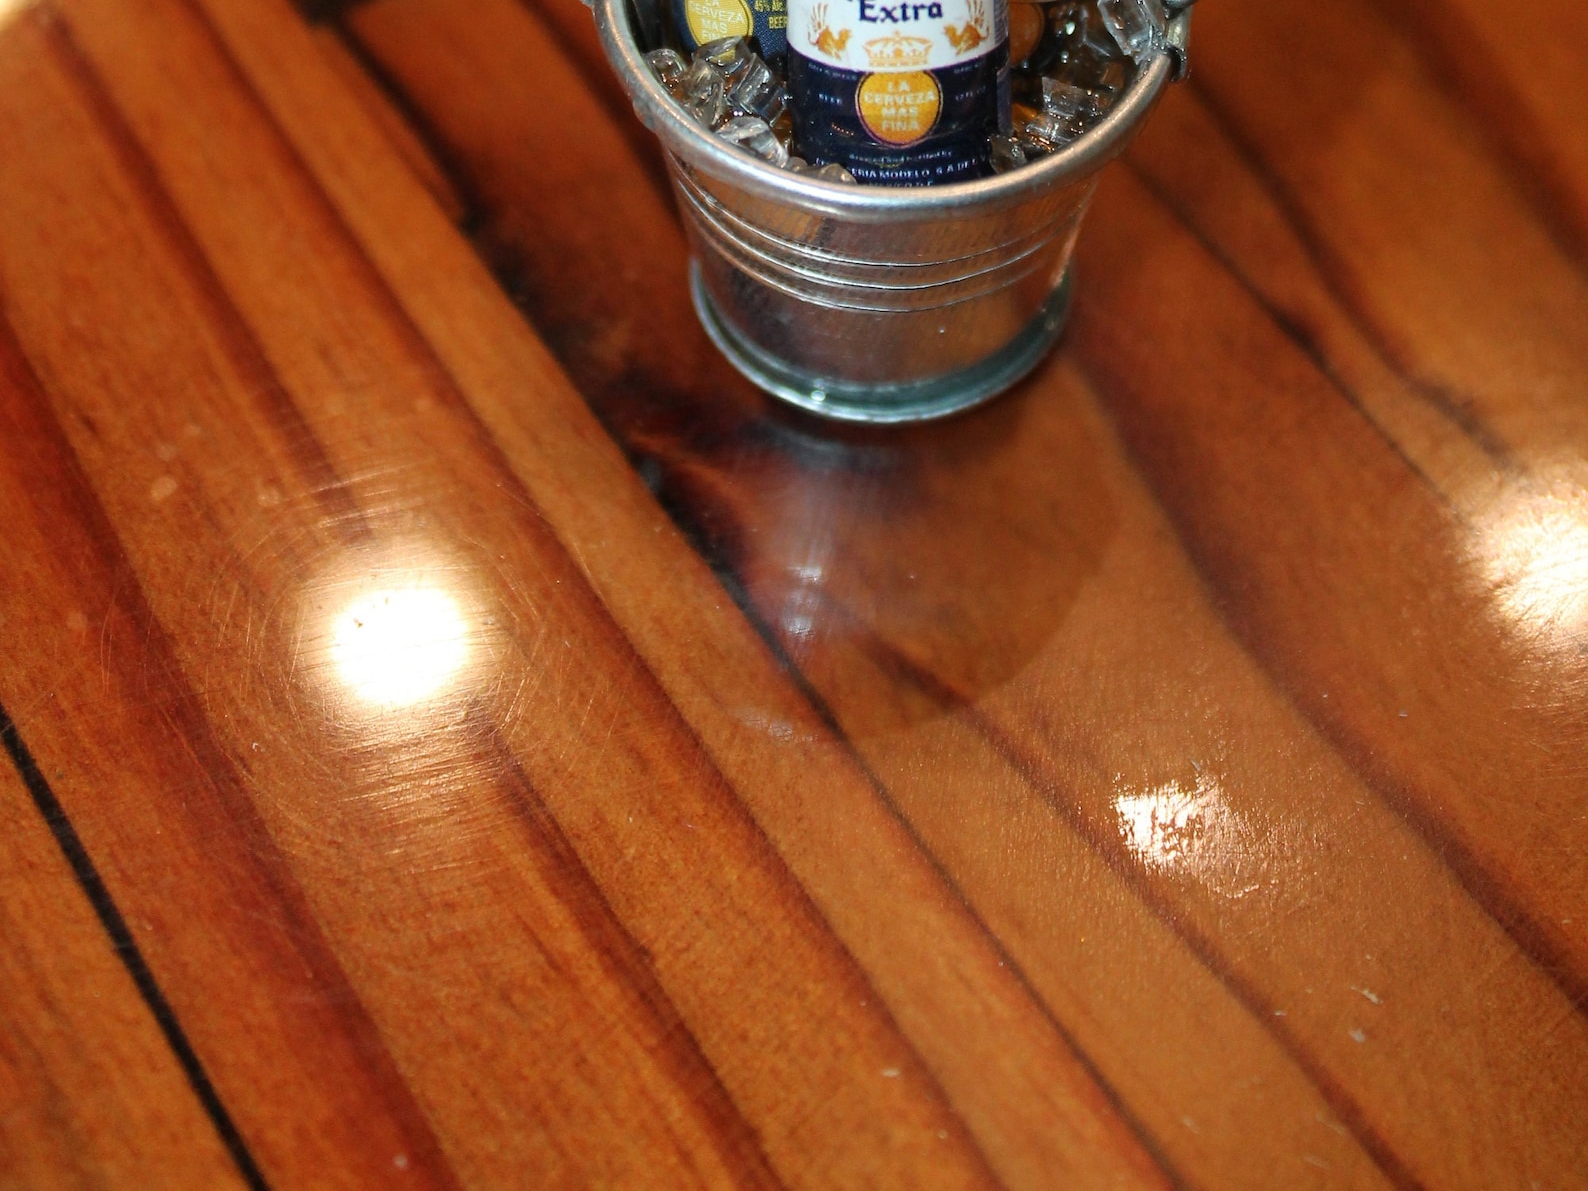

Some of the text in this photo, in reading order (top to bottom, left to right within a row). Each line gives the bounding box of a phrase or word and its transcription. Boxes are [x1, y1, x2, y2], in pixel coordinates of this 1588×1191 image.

[688, 0, 745, 24] CERVEZA
[887, 80, 911, 92] LA
[863, 90, 937, 106] CERVEZA
[881, 106, 919, 118] MAS
[881, 119, 920, 132] FINA
